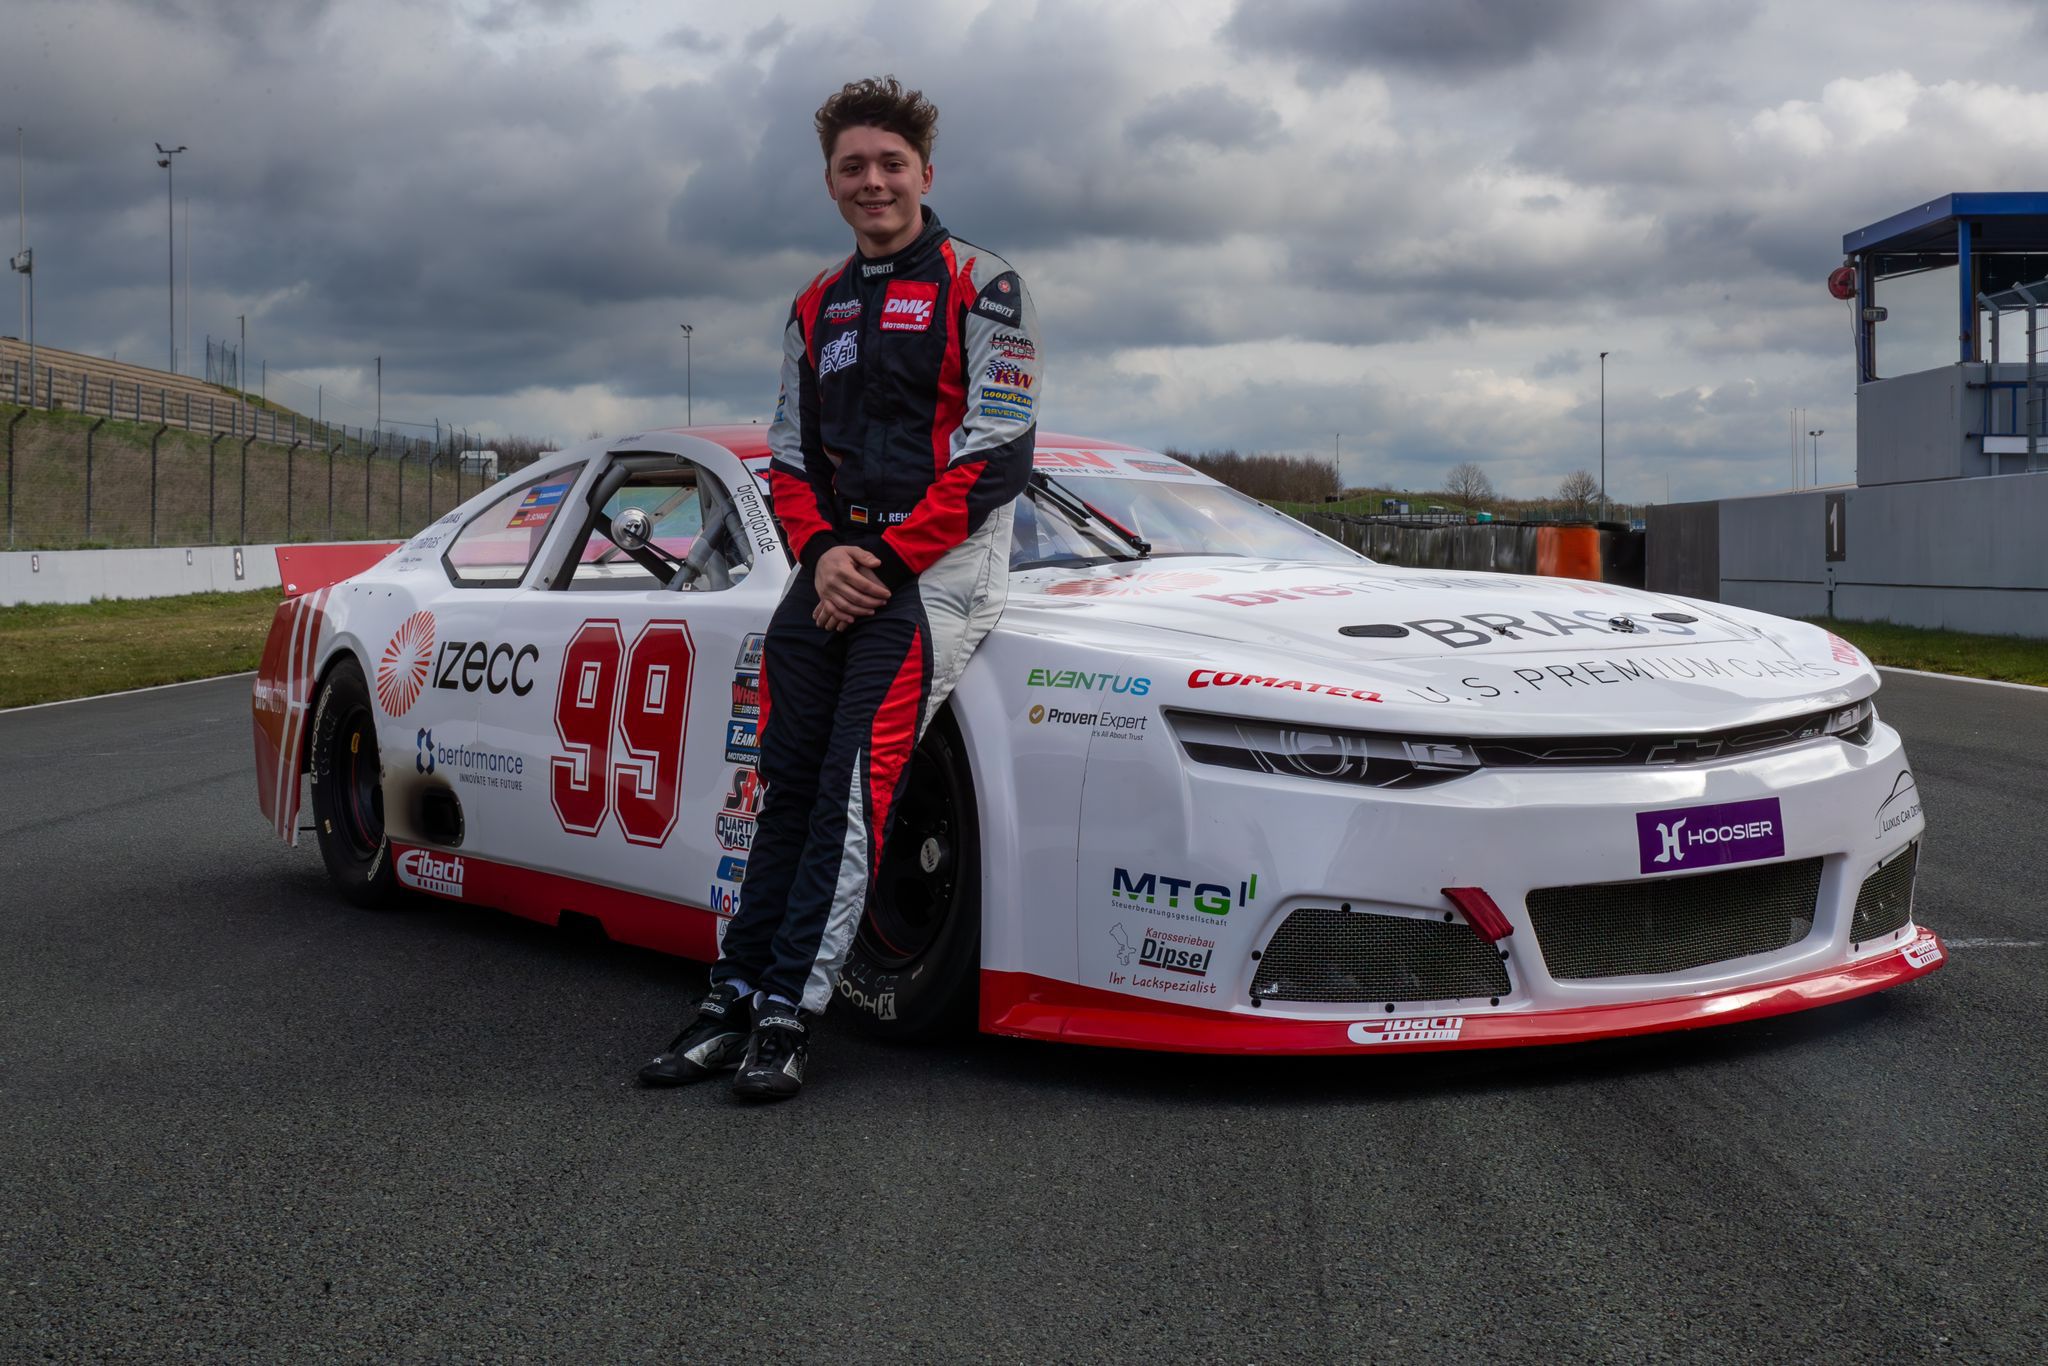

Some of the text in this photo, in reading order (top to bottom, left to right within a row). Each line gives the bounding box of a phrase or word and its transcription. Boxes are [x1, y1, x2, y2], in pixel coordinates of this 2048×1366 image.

[884, 298, 932, 314] DMV
[882, 321, 928, 330] MOTORSPORT
[983, 390, 1032, 406] GOODYEAR
[737, 484, 780, 554] bremotion.de
[888, 512, 913, 522] REH
[1830, 502, 1838, 552] 1
[1402, 609, 1697, 649] BRASS
[1186, 669, 1385, 704] COMATEQ
[1047, 708, 1148, 730] Proven Expert
[550, 618, 697, 849] 99
[1109, 731, 1127, 739] About
[1128, 732, 1144, 741] Trust
[438, 746, 524, 775] berformance
[459, 772, 523, 791] INNOVATE THE FUTURE
[717, 815, 753, 836] QUART
[1687, 820, 1774, 847] HOOSIER
[397, 850, 465, 897] Eibach
[1112, 867, 1231, 916] MTG
[1111, 900, 1228, 927] Steuerberatungsgesellschaft
[1145, 927, 1215, 949] Karosseriebau
[1140, 937, 1213, 970] Dipsel
[1109, 971, 1217, 994] Ihr Lackspezialist
